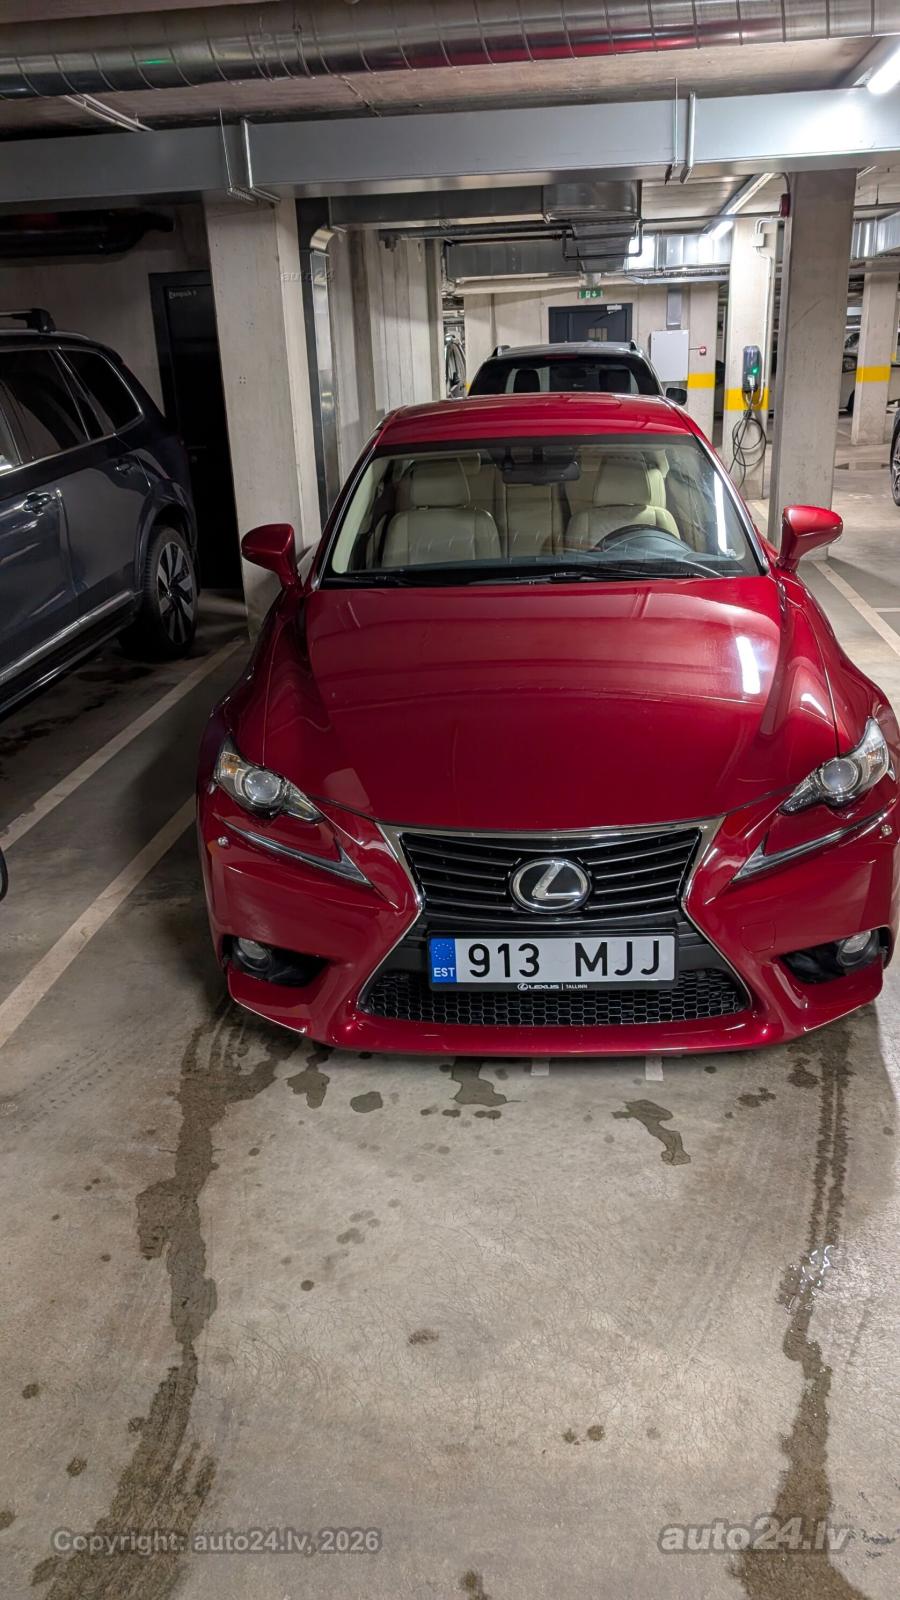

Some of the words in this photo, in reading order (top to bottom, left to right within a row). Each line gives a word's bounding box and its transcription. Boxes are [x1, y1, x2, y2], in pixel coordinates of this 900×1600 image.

[468, 943, 540, 978] 913
[574, 940, 660, 977] MJJ
[433, 967, 455, 978] EST
